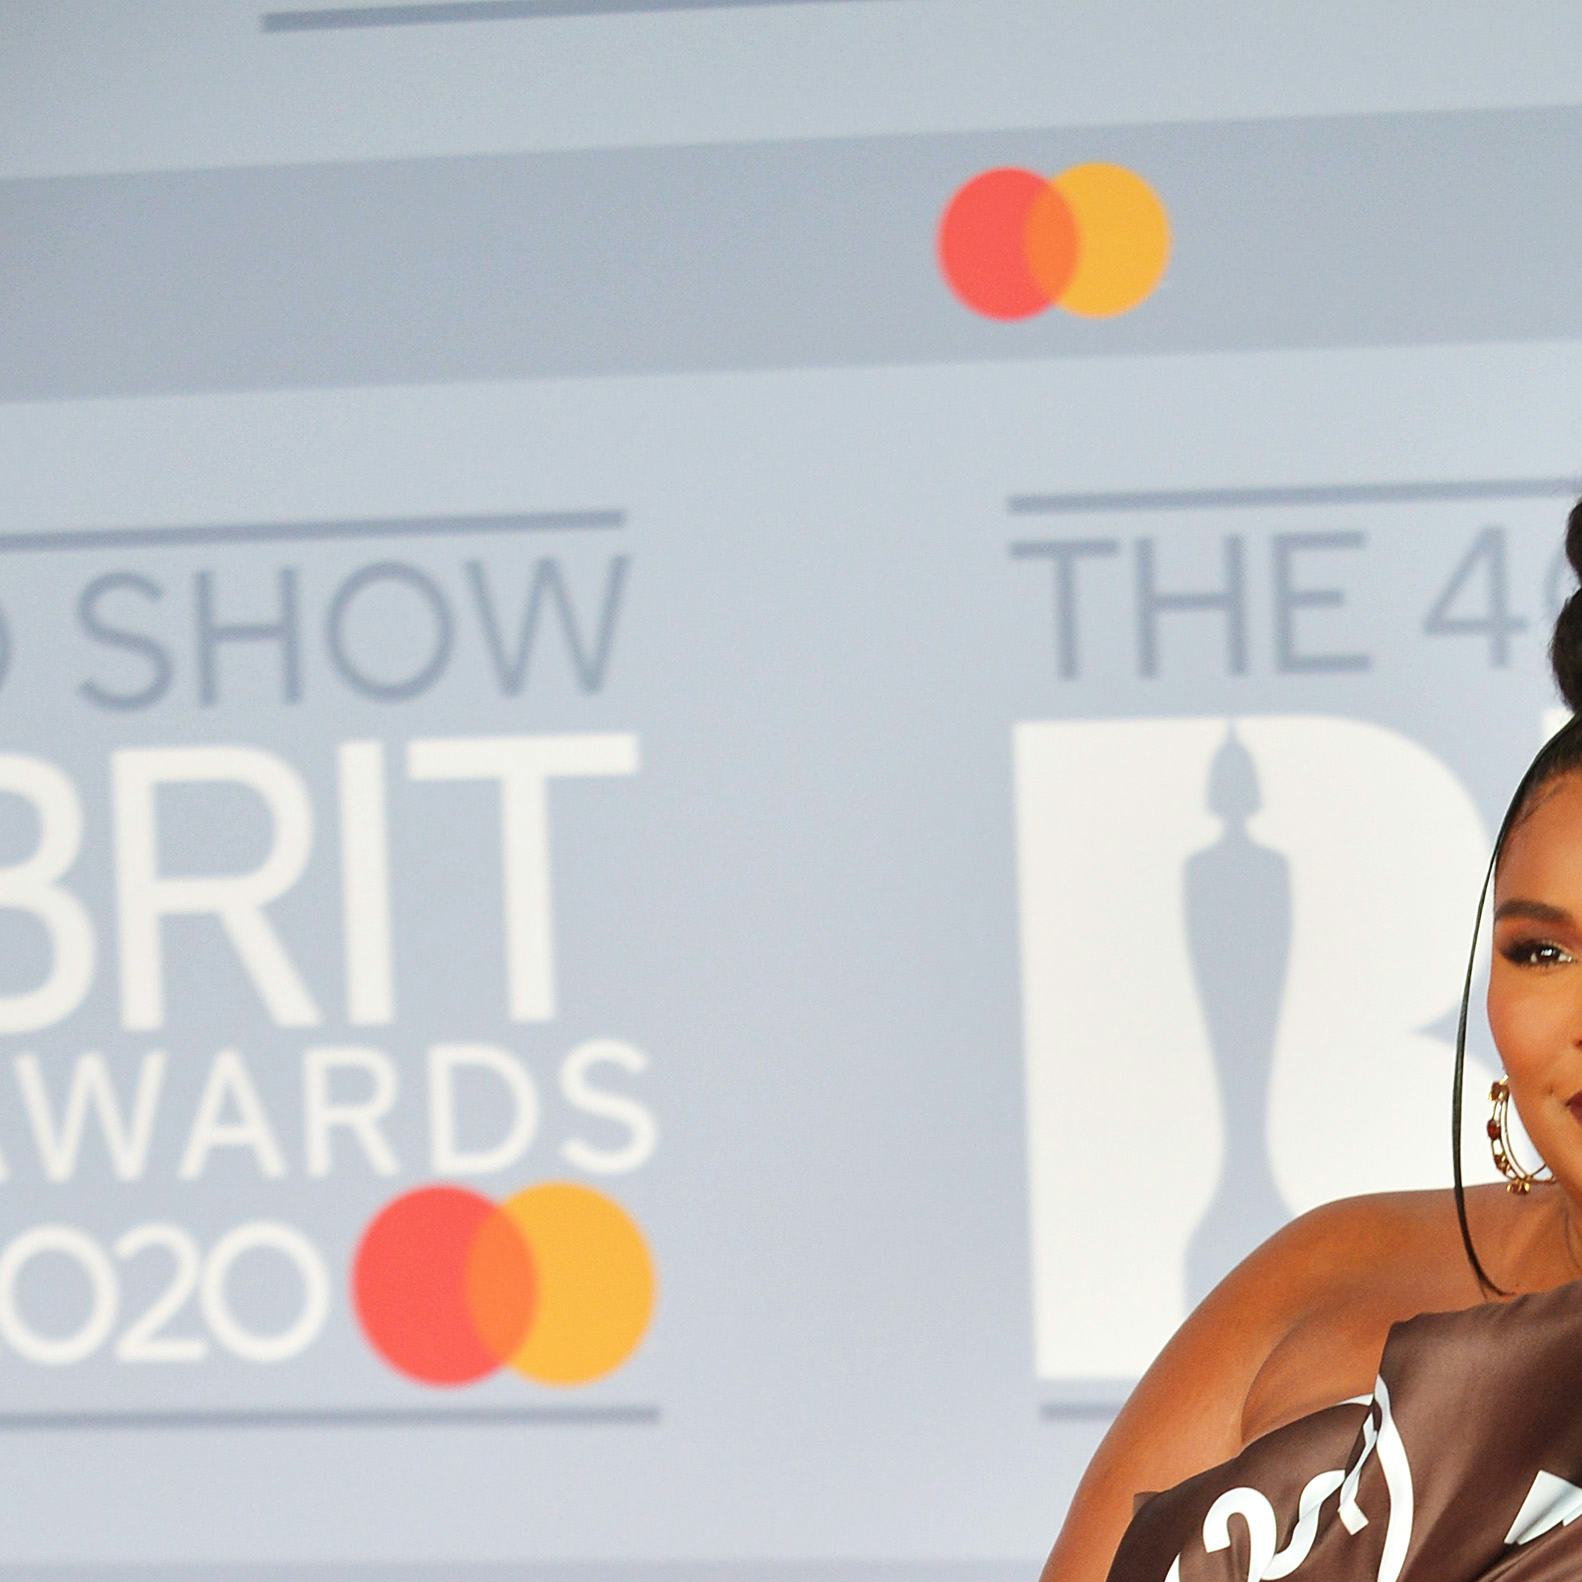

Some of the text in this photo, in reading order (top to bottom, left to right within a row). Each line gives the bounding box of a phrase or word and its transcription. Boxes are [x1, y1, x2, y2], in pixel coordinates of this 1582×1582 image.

[74, 553, 632, 714] SHOW
[1008, 529, 1373, 682] THE
[0, 1037, 660, 1184] WARDS
[0, 1219, 331, 1365] 020
